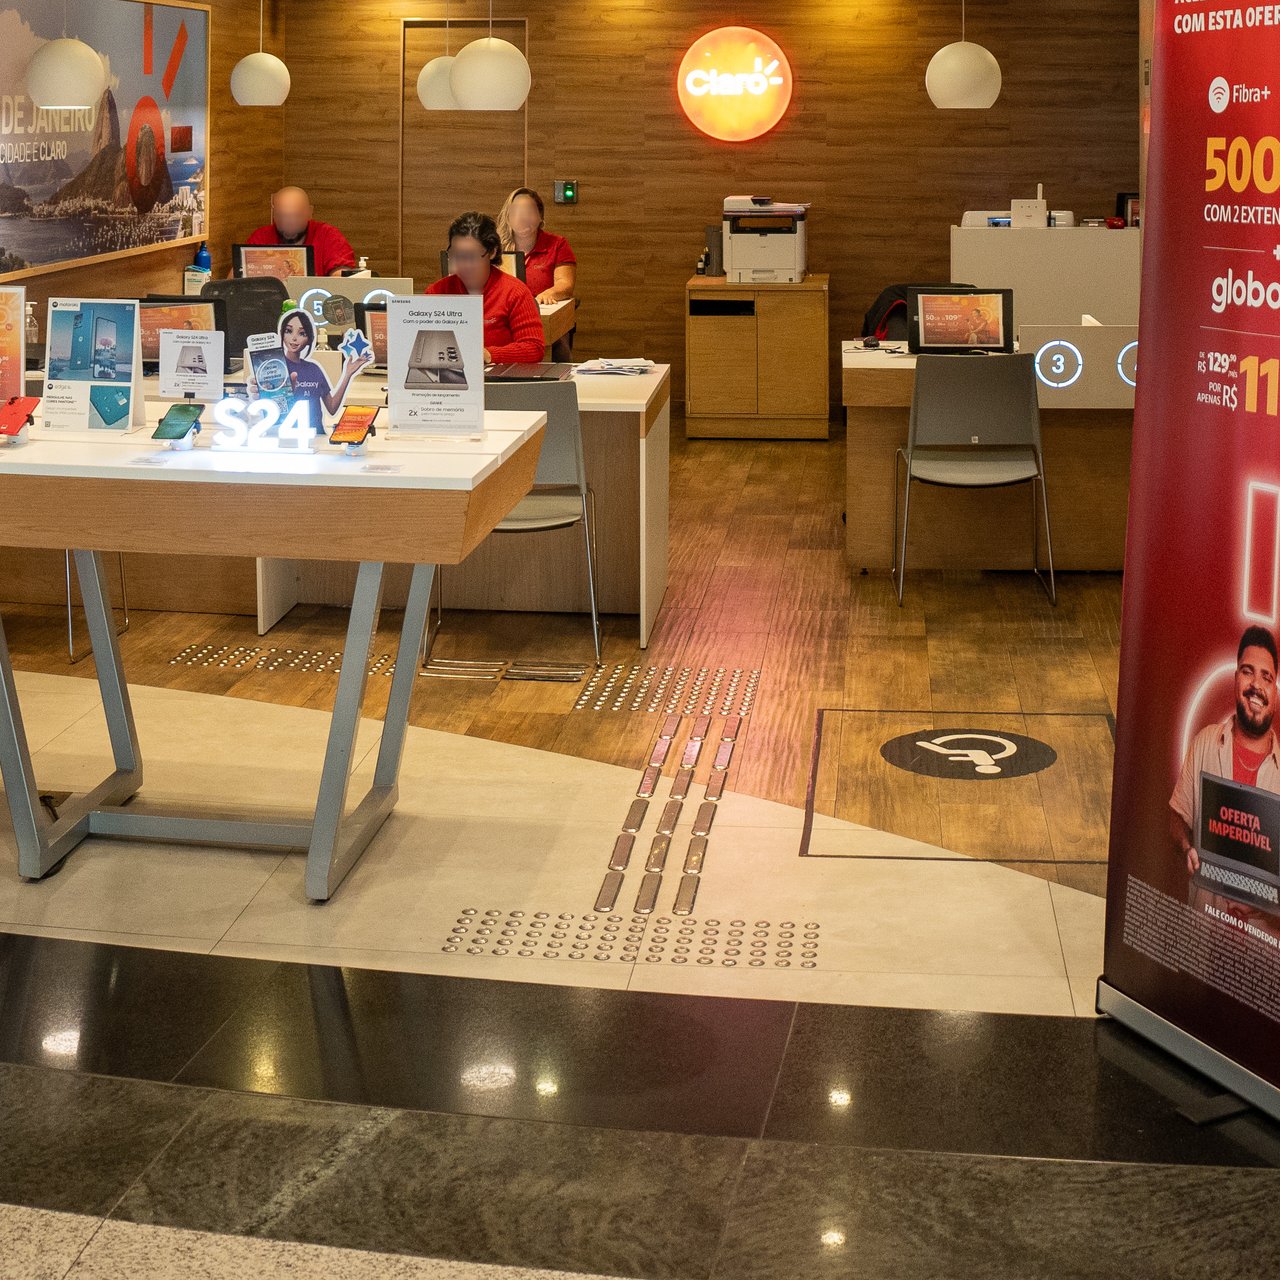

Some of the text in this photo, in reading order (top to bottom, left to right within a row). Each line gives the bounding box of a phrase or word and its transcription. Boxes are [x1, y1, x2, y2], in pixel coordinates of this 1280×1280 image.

[1173, 12, 1205, 34] COM
[1208, 8, 1243, 31] ESTA
[684, 68, 769, 97] Claro
[1232, 84, 1271, 104] Fibra+
[1, 95, 25, 135] DE
[28, 104, 96, 134] JANEIRO
[32, 136, 38, 162] É
[39, 140, 68, 161] CLARO
[1204, 204, 1231, 222] COM
[1232, 205, 1239, 223] 2
[313, 300, 323, 316] 5
[408, 310, 433, 319] Galaxy
[1051, 353, 1065, 374] 3
[1197, 360, 1207, 374] R$
[1196, 393, 1221, 406] APENAS
[1222, 384, 1238, 411] R$
[1208, 381, 1221, 393] POR
[213, 397, 318, 450] S24
[408, 409, 418, 417] 2x
[1220, 805, 1261, 831] OFERTA
[1208, 818, 1272, 852] IMPERDÍVEL
[1204, 903, 1220, 919] FALE
[1220, 912, 1237, 927] COM
[1237, 919, 1244, 929] O
[1244, 922, 1278, 947] VENDEDOR
